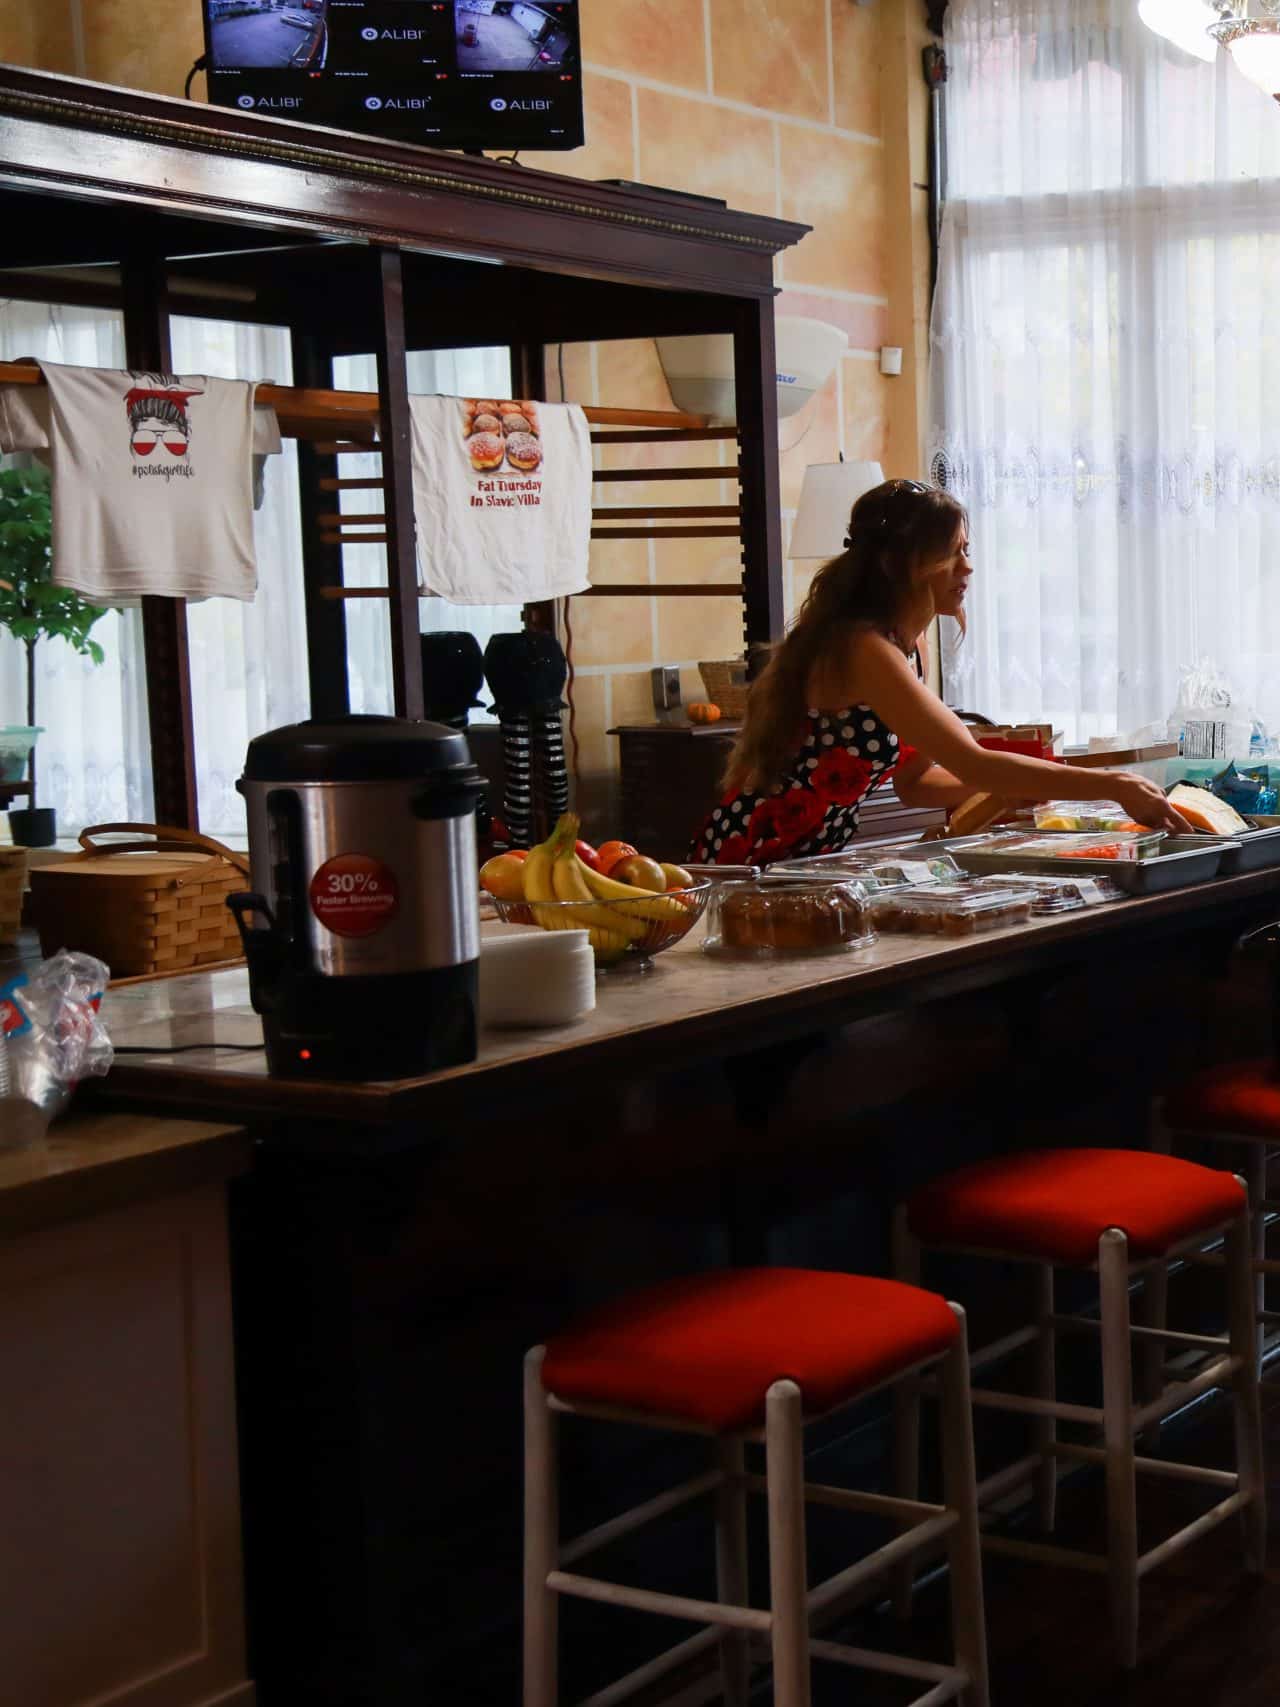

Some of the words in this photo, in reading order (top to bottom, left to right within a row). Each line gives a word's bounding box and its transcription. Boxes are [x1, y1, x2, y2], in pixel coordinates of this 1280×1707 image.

[380, 29, 422, 40] ALIBI
[257, 96, 300, 108] ALIBI
[384, 98, 425, 109] ALIBI
[509, 99, 550, 110] ALIBI
[477, 480, 495, 492] Fat
[470, 495, 483, 507] In
[486, 495, 514, 507] Slavic
[327, 872, 379, 894] 30%
